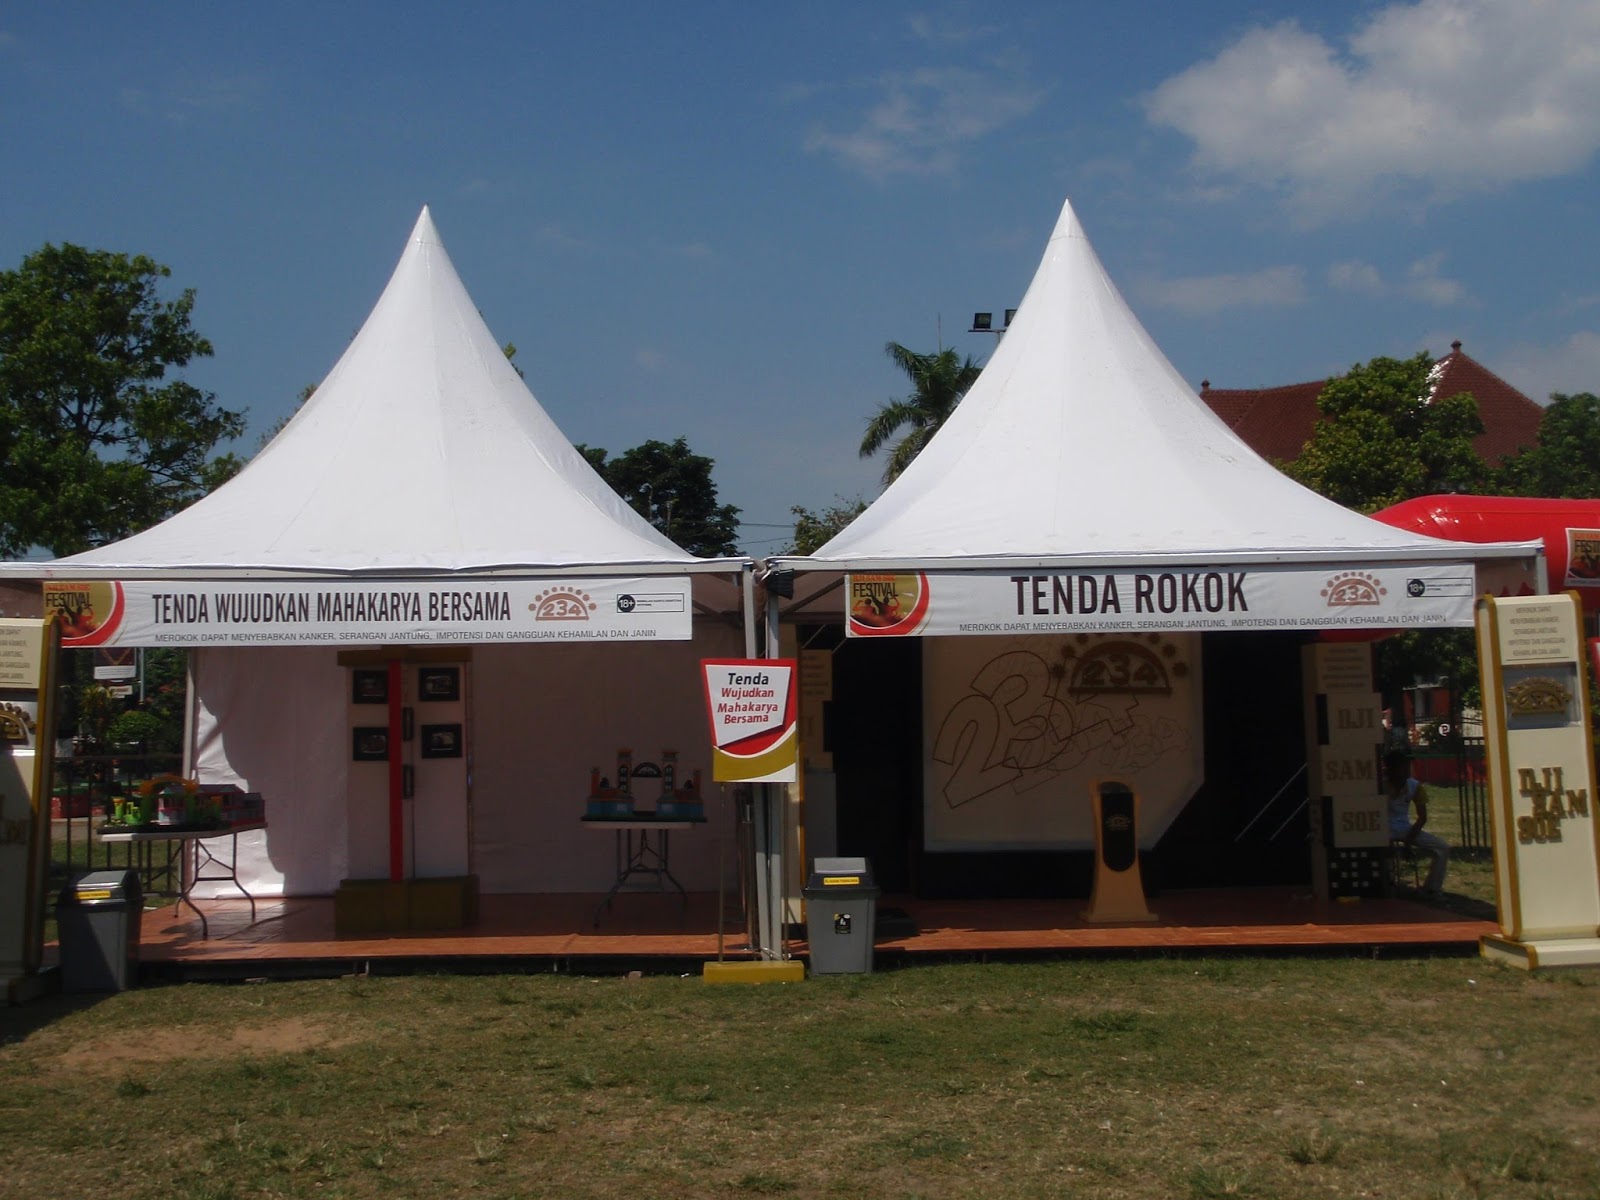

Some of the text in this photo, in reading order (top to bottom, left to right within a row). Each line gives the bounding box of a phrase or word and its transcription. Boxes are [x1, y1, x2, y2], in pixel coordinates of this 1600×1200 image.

[853, 582, 899, 597] FESTIVAL
[1011, 572, 1248, 615] TENDA ROKOK
[1334, 585, 1373, 602] 234
[1409, 583, 1424, 593] 18+
[46, 592, 92, 607] FESTIVAL
[152, 591, 511, 623] TENDA WUJUDKAN MAHAKARYA BERSAMA
[619, 598, 635, 608] 18+
[543, 599, 582, 617] 234
[959, 623, 1001, 631] MEROKOK
[1004, 622, 1031, 630] DAPAT
[1033, 621, 1096, 630] MENYEBABKAN
[1137, 620, 1184, 628] SERANGAN
[1185, 619, 1228, 628] JANTUNG,
[1232, 619, 1277, 627] IMPOTENSI
[1279, 618, 1297, 626] DAN
[1300, 617, 1347, 625] GANGGUAN
[1350, 616, 1399, 624] KEHAMILAN
[1402, 615, 1419, 624] DAN
[155, 633, 199, 642] MEROKOK
[201, 633, 229, 641] DAPAT
[231, 633, 297, 641] MENYEBABKAN
[339, 632, 386, 640] SERANGAN
[389, 631, 432, 640] JANTUNG,
[436, 631, 483, 639] IMPOTENSI
[485, 631, 503, 639] DAN
[506, 631, 555, 639] GANGGUAN
[557, 630, 608, 638] KEHAMILAN
[610, 630, 629, 638] DAN
[631, 629, 656, 637] JANIN
[728, 672, 769, 685] Tenda
[1081, 655, 1160, 687] 234
[721, 687, 774, 700] Wujudkan
[717, 702, 778, 713] Mahakarya
[724, 714, 769, 724] Bersama
[1337, 708, 1374, 729] DJI
[1325, 759, 1374, 781] SAM
[1343, 811, 1380, 832] SOE
